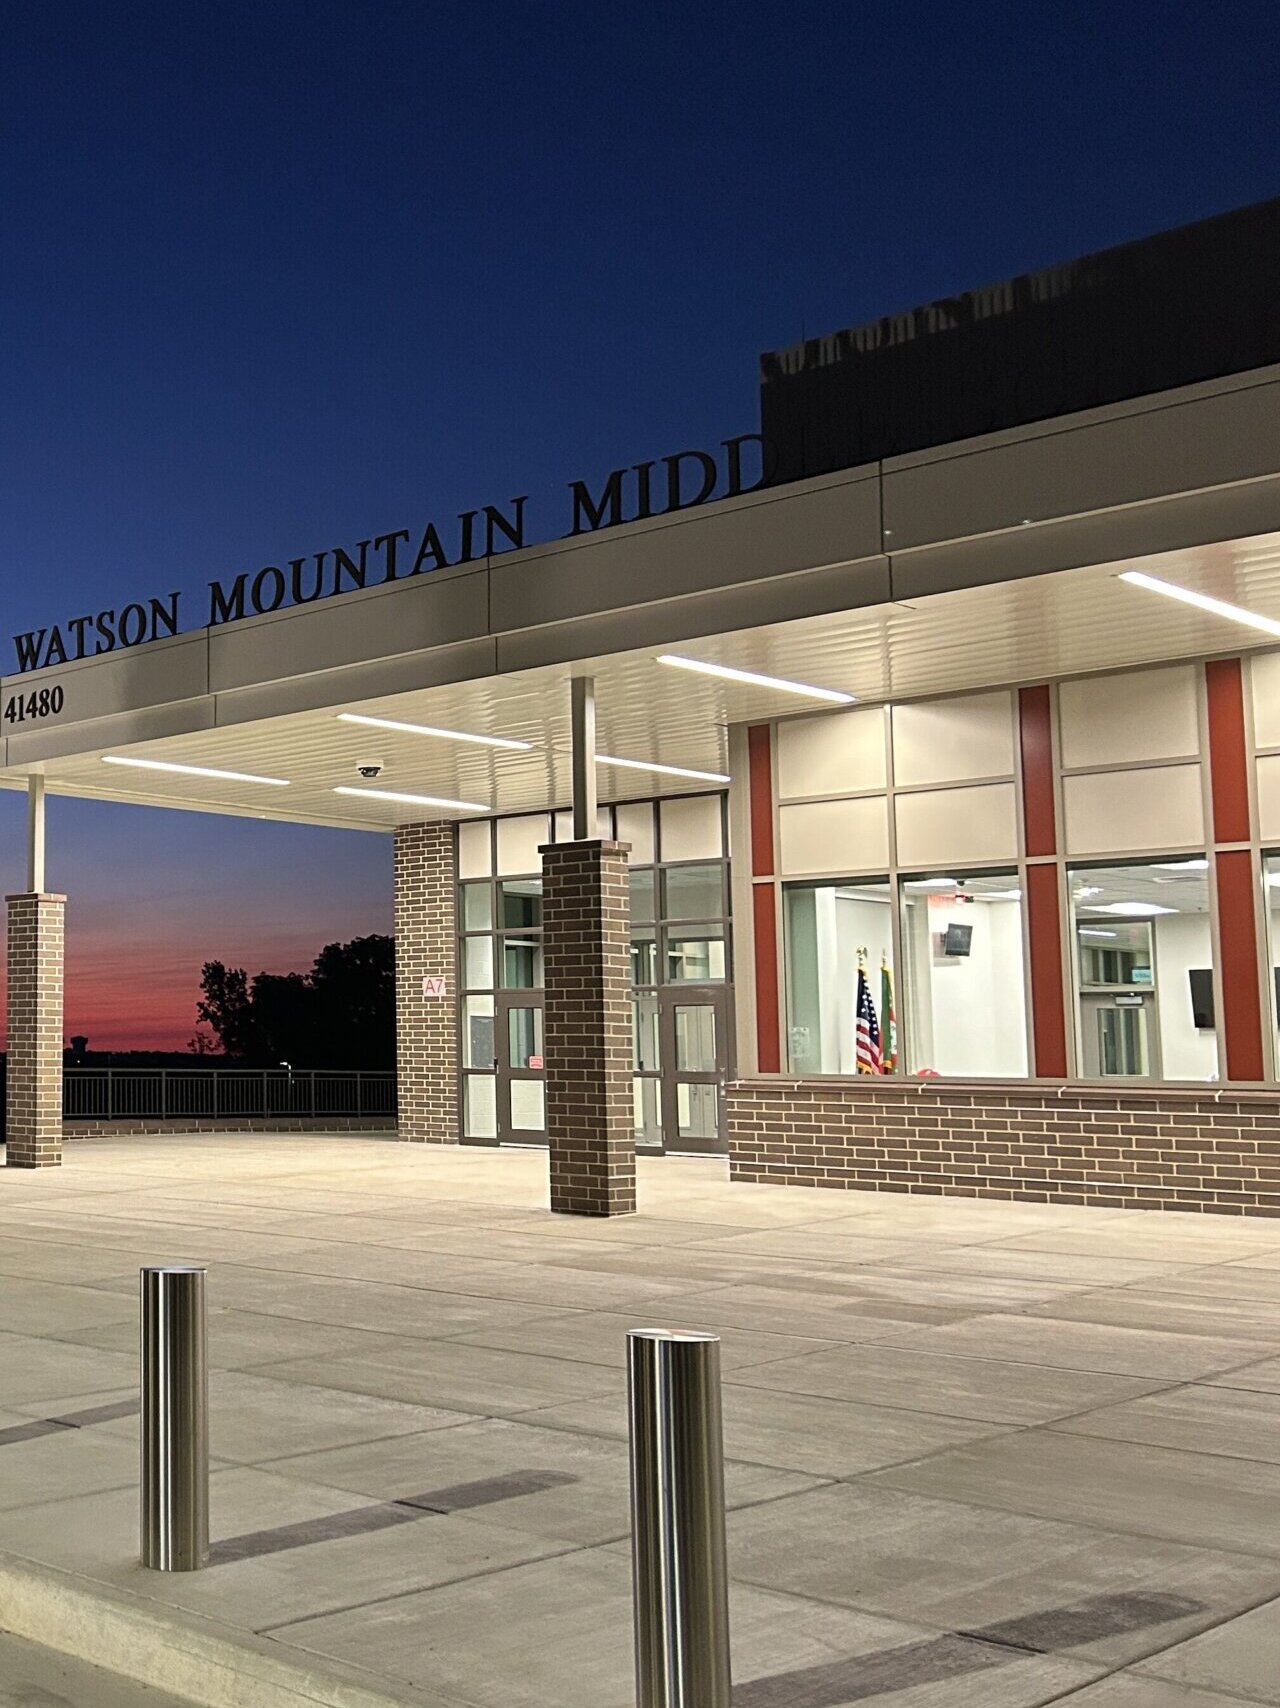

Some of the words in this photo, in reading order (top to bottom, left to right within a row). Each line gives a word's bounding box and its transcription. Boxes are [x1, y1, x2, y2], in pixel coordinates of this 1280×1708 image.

[12, 592, 182, 672] WATSON
[203, 496, 532, 627] MOUNTAIN
[4, 685, 64, 723] 41480
[425, 978, 443, 994] A7
